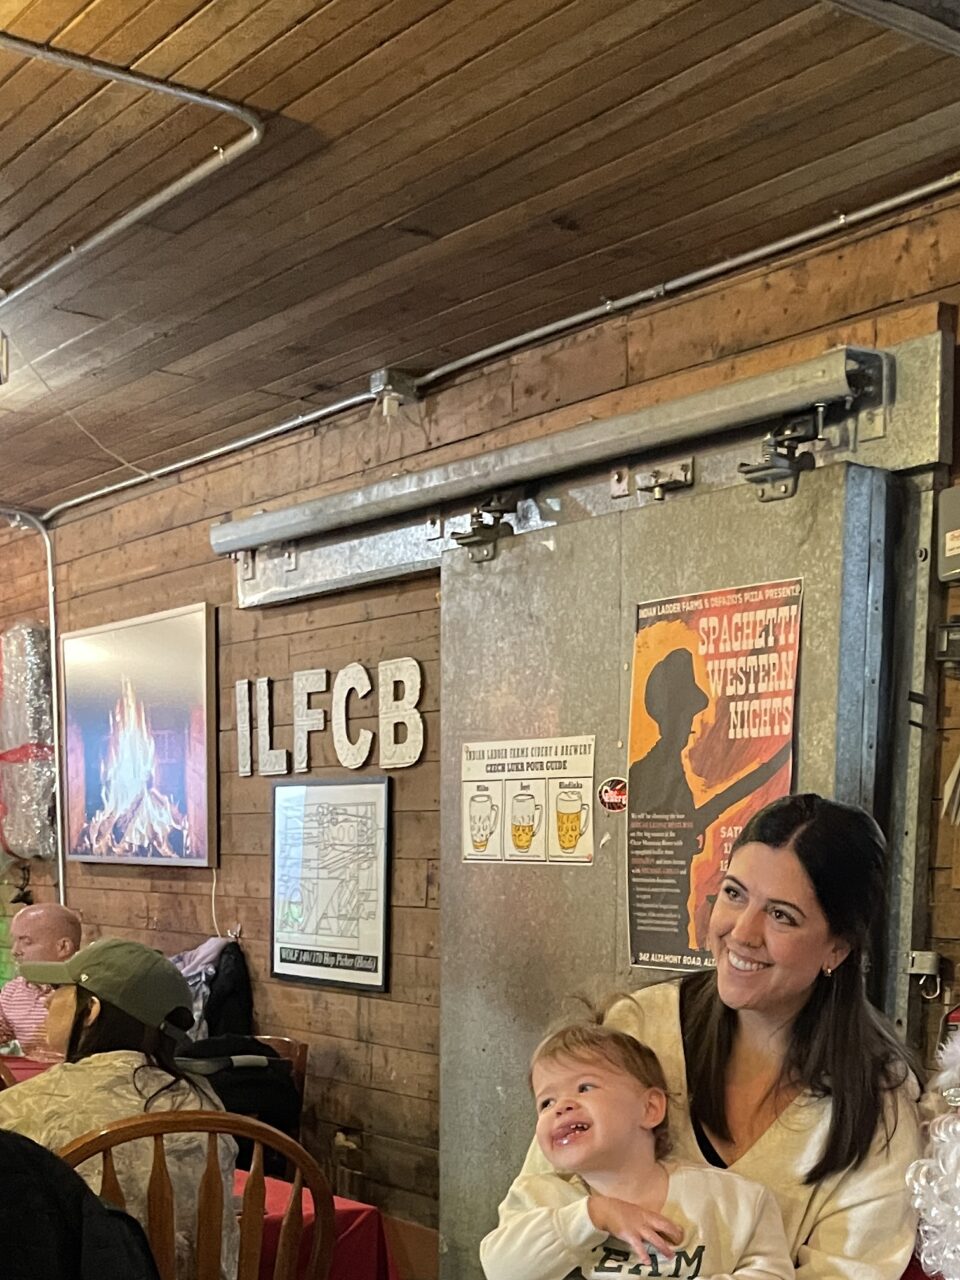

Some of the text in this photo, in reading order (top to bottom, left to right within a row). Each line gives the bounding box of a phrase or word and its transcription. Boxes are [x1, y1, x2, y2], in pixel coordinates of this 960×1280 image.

[639, 608, 656, 618] INDIAN
[658, 602, 682, 616] LADDER
[682, 600, 702, 612] FARMS
[744, 591, 763, 603] PIZZA
[698, 604, 798, 656] SPAGHETTI
[706, 650, 795, 699] WESTERN
[235, 656, 424, 778] ILFCB
[728, 695, 793, 740] NIGHTS
[487, 748, 508, 760] LADDER
[510, 747, 528, 759] FARMS
[530, 745, 553, 758] CIDERY
[560, 743, 592, 756] BREWERY
[526, 761, 544, 772] POUR
[546, 760, 568, 770] GUIDE
[281, 949, 299, 961] WOLF
[336, 954, 354, 966] Picker
[638, 952, 649, 962] 342
[650, 954, 682, 964] ALTAMONT
[682, 956, 702, 967] ROAD,
[592, 1245, 706, 1280] EAM
